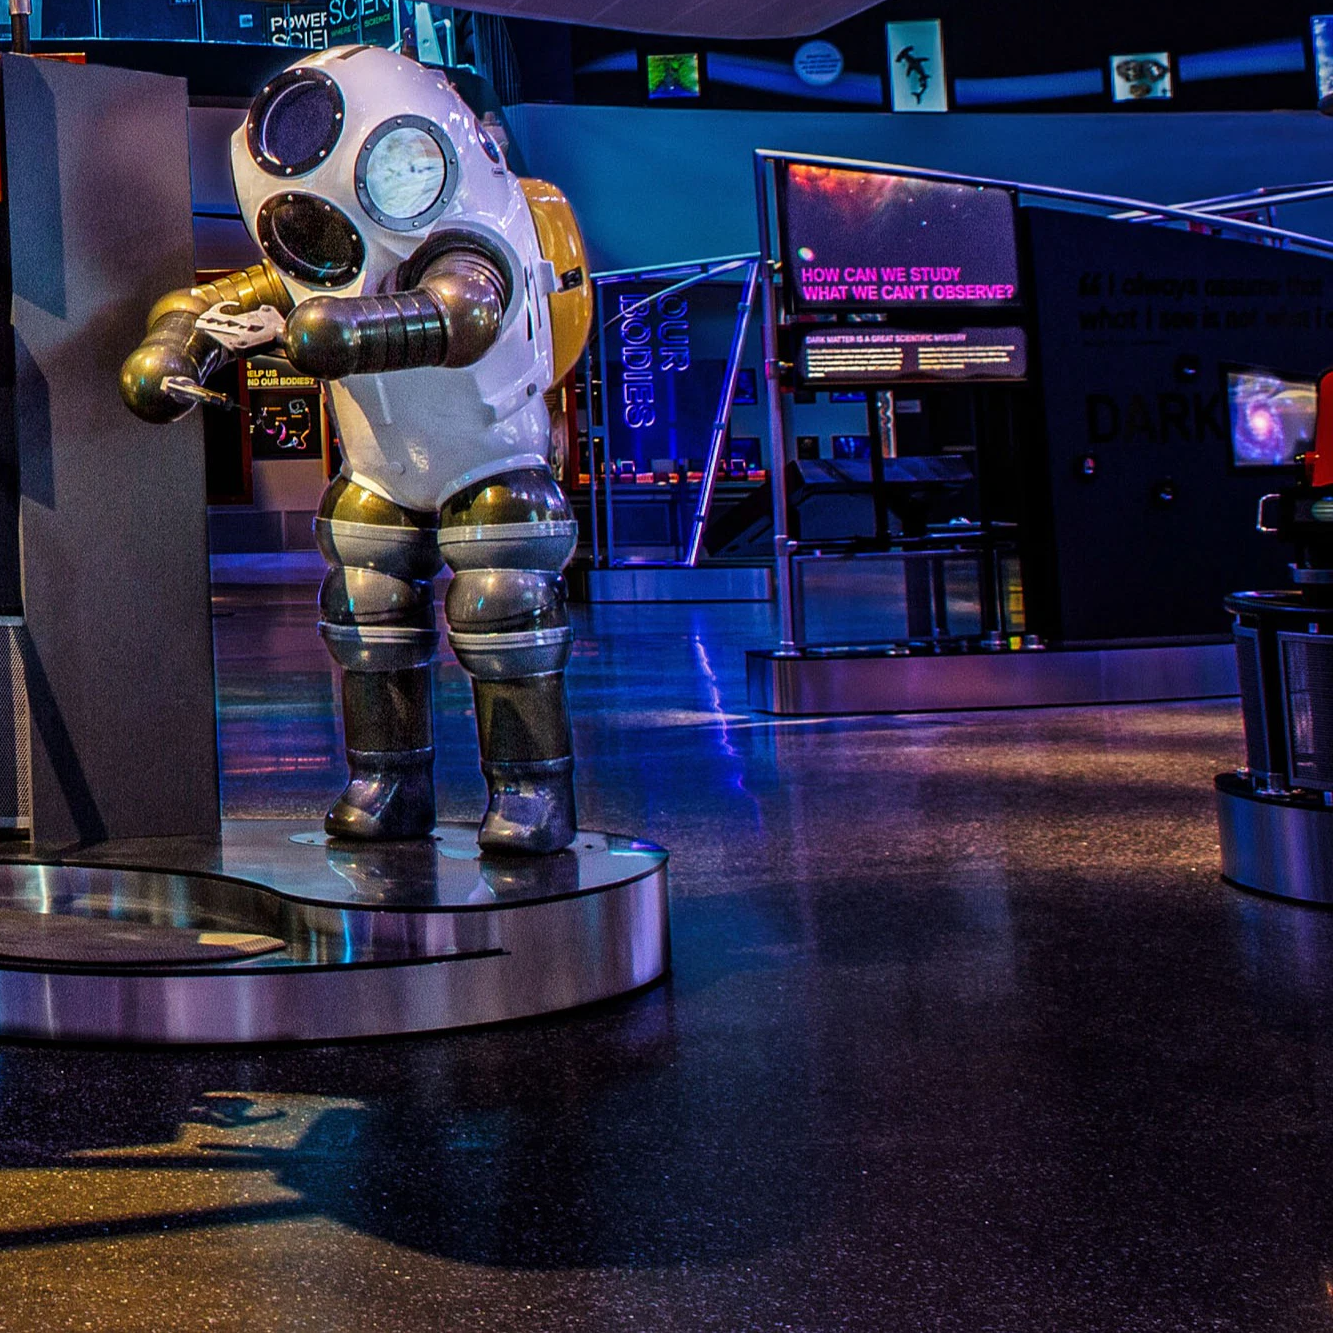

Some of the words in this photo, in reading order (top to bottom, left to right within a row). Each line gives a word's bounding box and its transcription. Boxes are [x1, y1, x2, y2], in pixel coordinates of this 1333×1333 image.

[364, 13, 391, 28] SCIENCE
[801, 267, 840, 282] HOW
[843, 267, 878, 282] CAN
[880, 267, 907, 282] WE
[909, 267, 961, 282] STUDY
[802, 285, 849, 300] WHAT
[851, 285, 879, 300] WE
[880, 285, 930, 300] CAN'T
[932, 284, 1014, 300] OBSERVE?
[657, 292, 689, 371] OUR
[619, 294, 656, 428] BODIES
[1086, 393, 1225, 443] DARK
